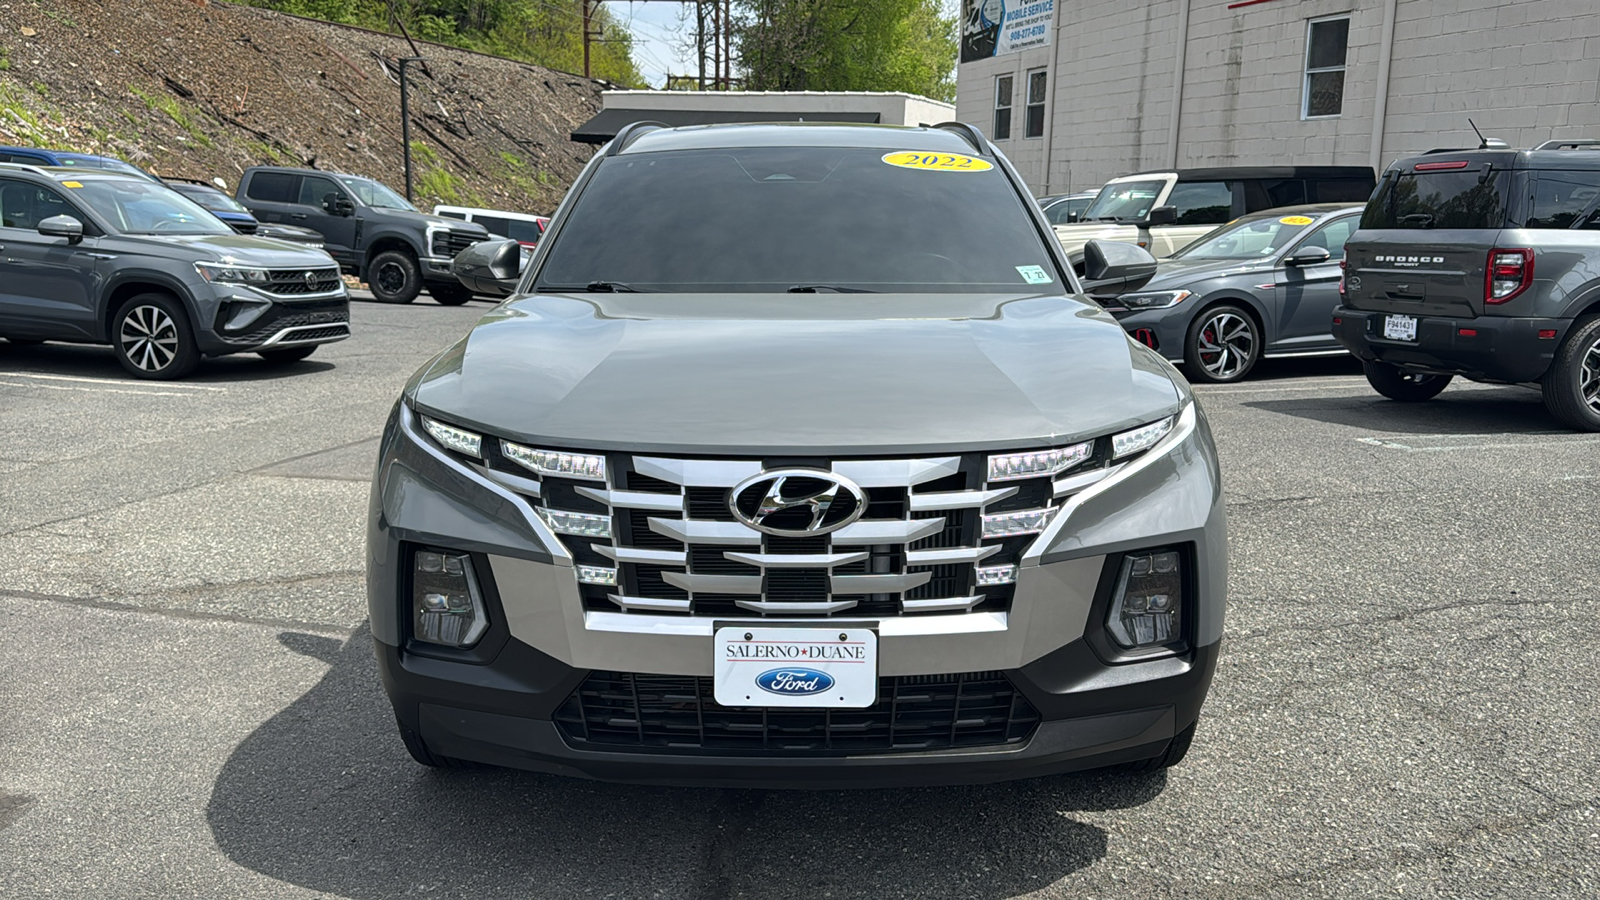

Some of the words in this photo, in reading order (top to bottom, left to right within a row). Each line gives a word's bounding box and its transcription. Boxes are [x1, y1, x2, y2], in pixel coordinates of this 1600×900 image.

[1006, 7, 1028, 22] MOBILE
[1028, 0, 1053, 16] SERVICE
[903, 154, 973, 168] 2022
[1375, 255, 1445, 263] BRONCO
[1024, 271, 1031, 280] 7
[1035, 271, 1045, 279] 27
[1387, 320, 1414, 330] F941431
[726, 644, 800, 658] SALERNO
[809, 646, 866, 660] DUANE
[771, 671, 819, 692] Ford
